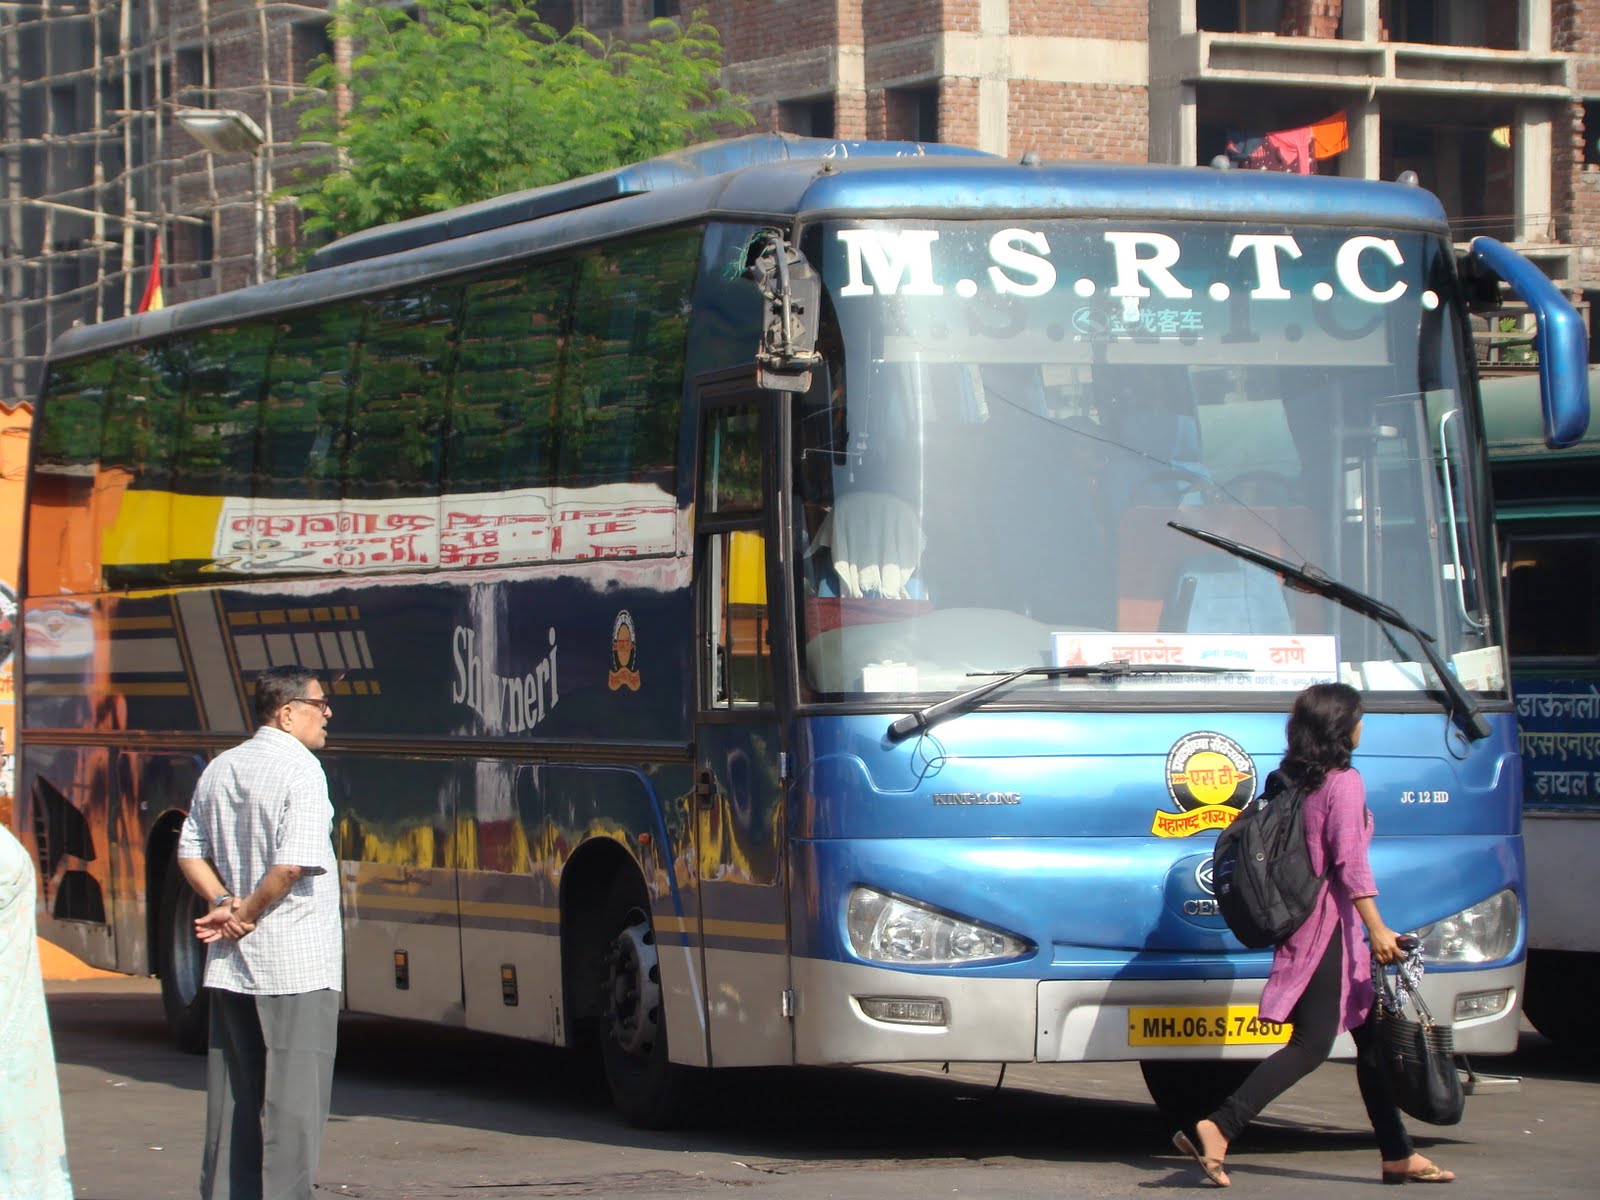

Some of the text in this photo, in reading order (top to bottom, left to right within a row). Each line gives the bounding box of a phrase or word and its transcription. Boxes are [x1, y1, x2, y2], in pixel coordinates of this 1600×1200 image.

[837, 227, 1440, 311] M.S.R.T.C.
[1269, 640, 1305, 664] ठाणे
[1516, 684, 1600, 719] डाऊनलो
[1534, 771, 1590, 796] डायल
[1401, 791, 1449, 804] JC 12 HD
[1201, 809, 1227, 826] राज्य
